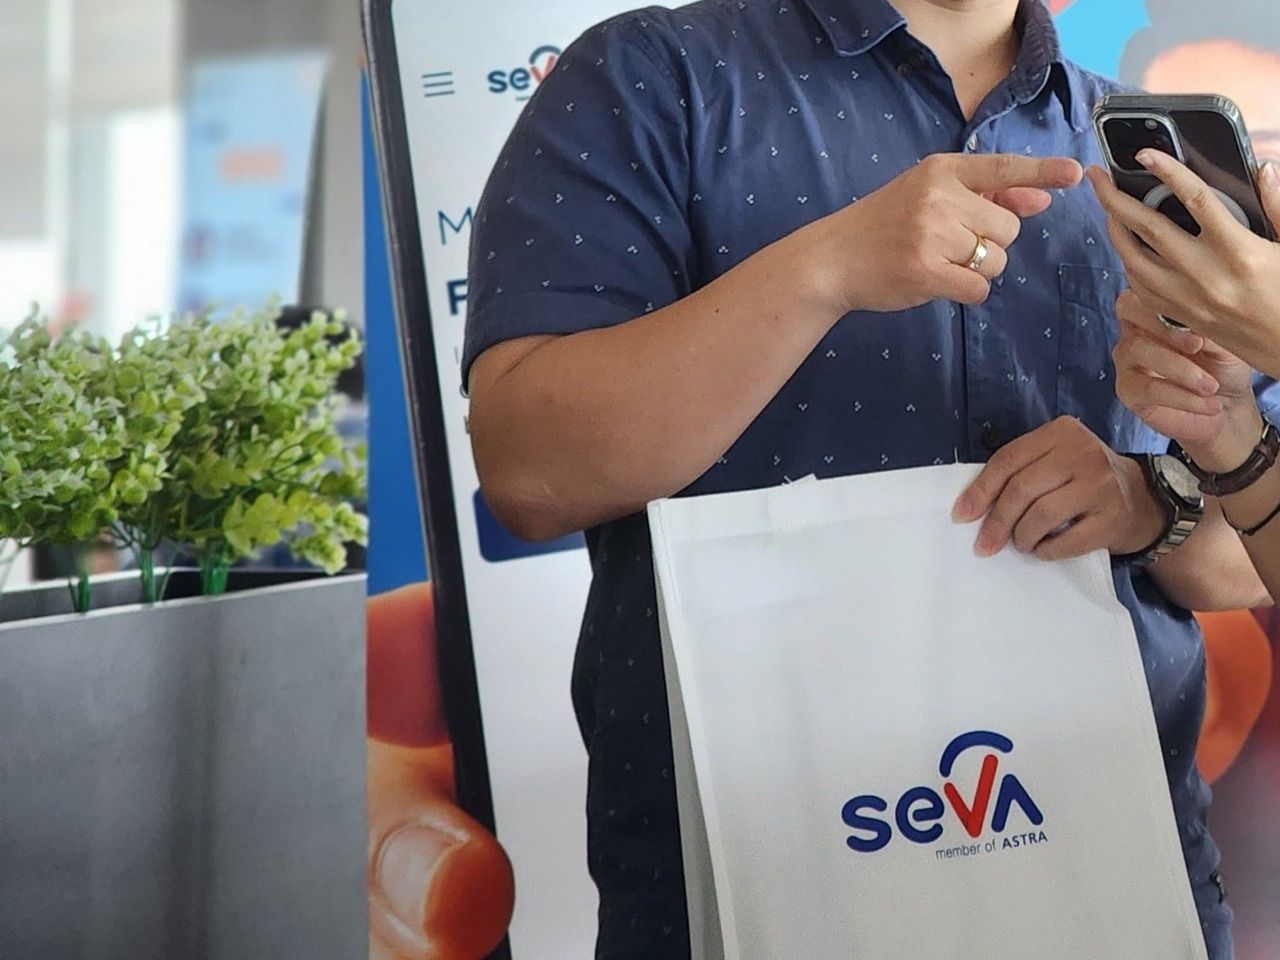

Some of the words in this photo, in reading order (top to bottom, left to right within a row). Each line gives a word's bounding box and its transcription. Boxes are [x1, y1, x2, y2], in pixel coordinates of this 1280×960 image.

[488, 54, 558, 93] seV
[935, 844, 981, 860] member
[985, 838, 996, 853] of
[1002, 831, 1049, 850] ASTRA
